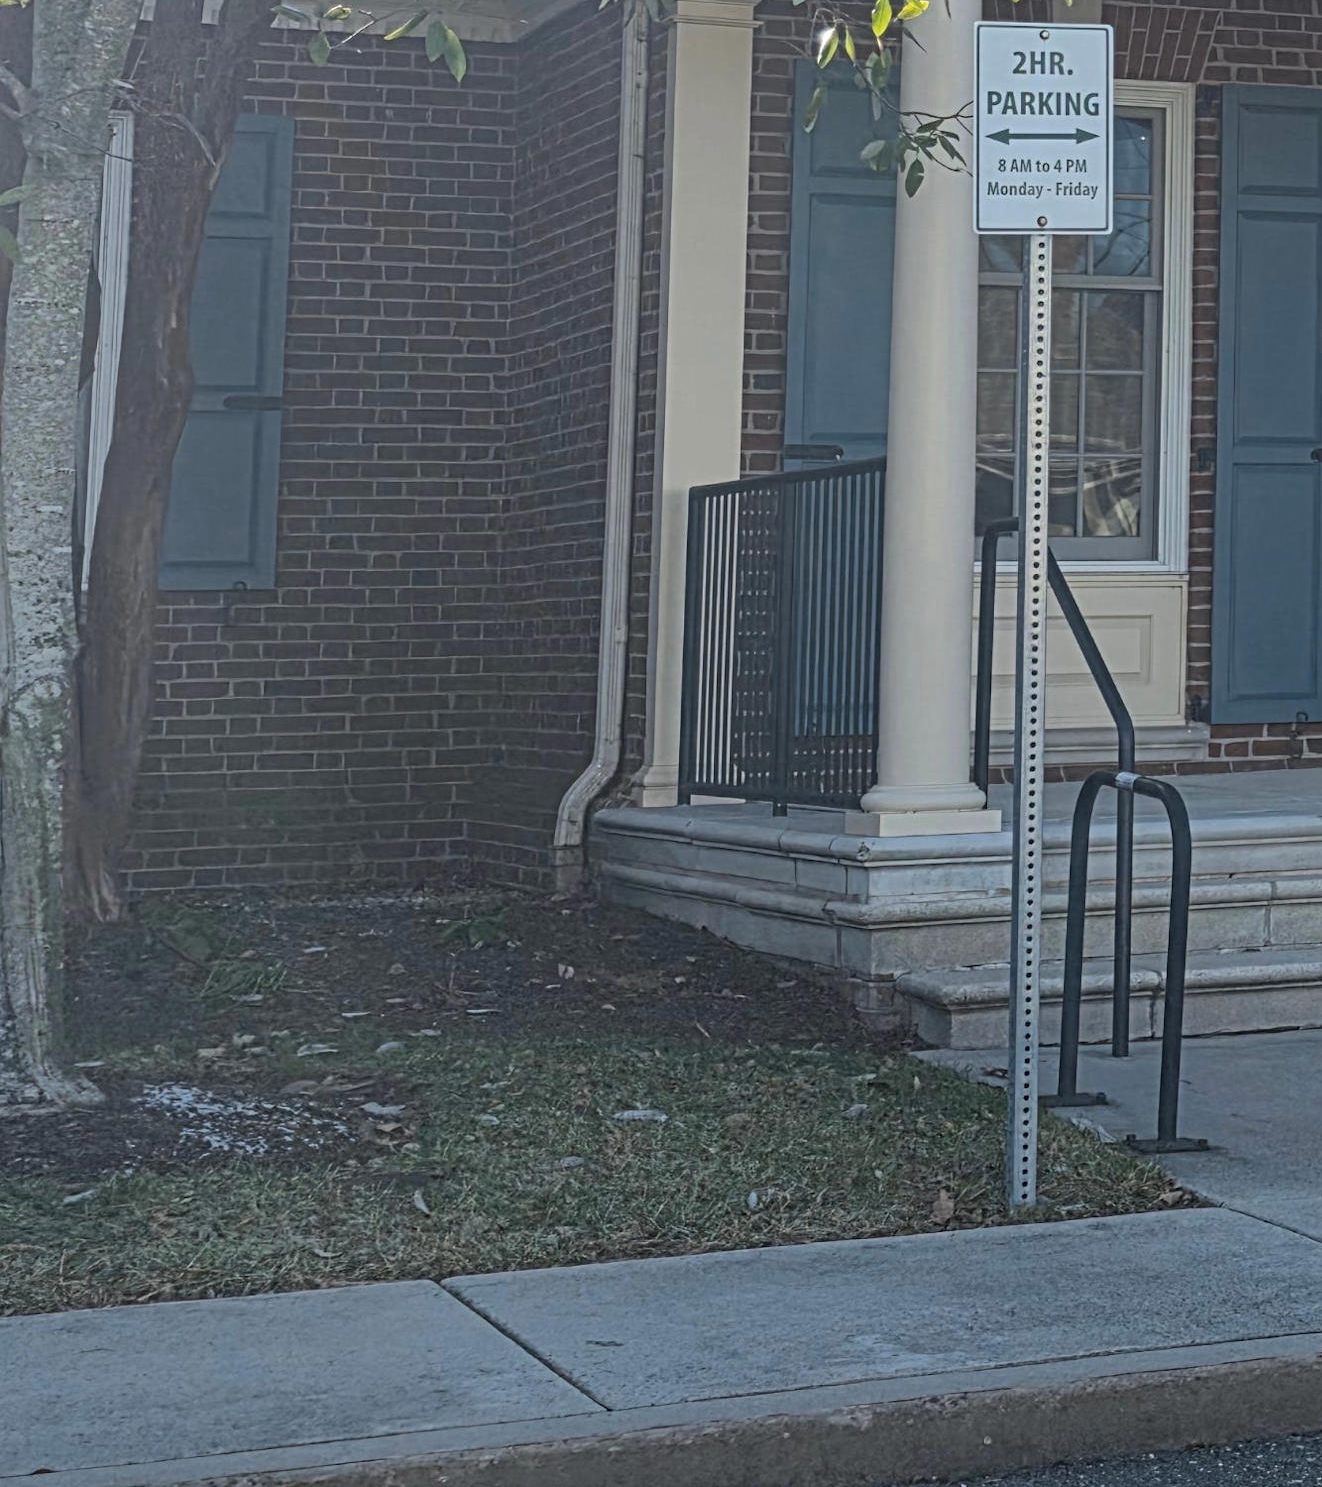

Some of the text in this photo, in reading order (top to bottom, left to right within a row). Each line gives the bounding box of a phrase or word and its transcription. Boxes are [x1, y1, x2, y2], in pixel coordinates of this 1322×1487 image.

[1012, 51, 1074, 76] 2HR.
[986, 90, 1100, 117] PARKING
[998, 159, 1087, 173] 8 AM to 4 PM
[987, 181, 1043, 199] Monday
[1056, 182, 1098, 200] Friday
